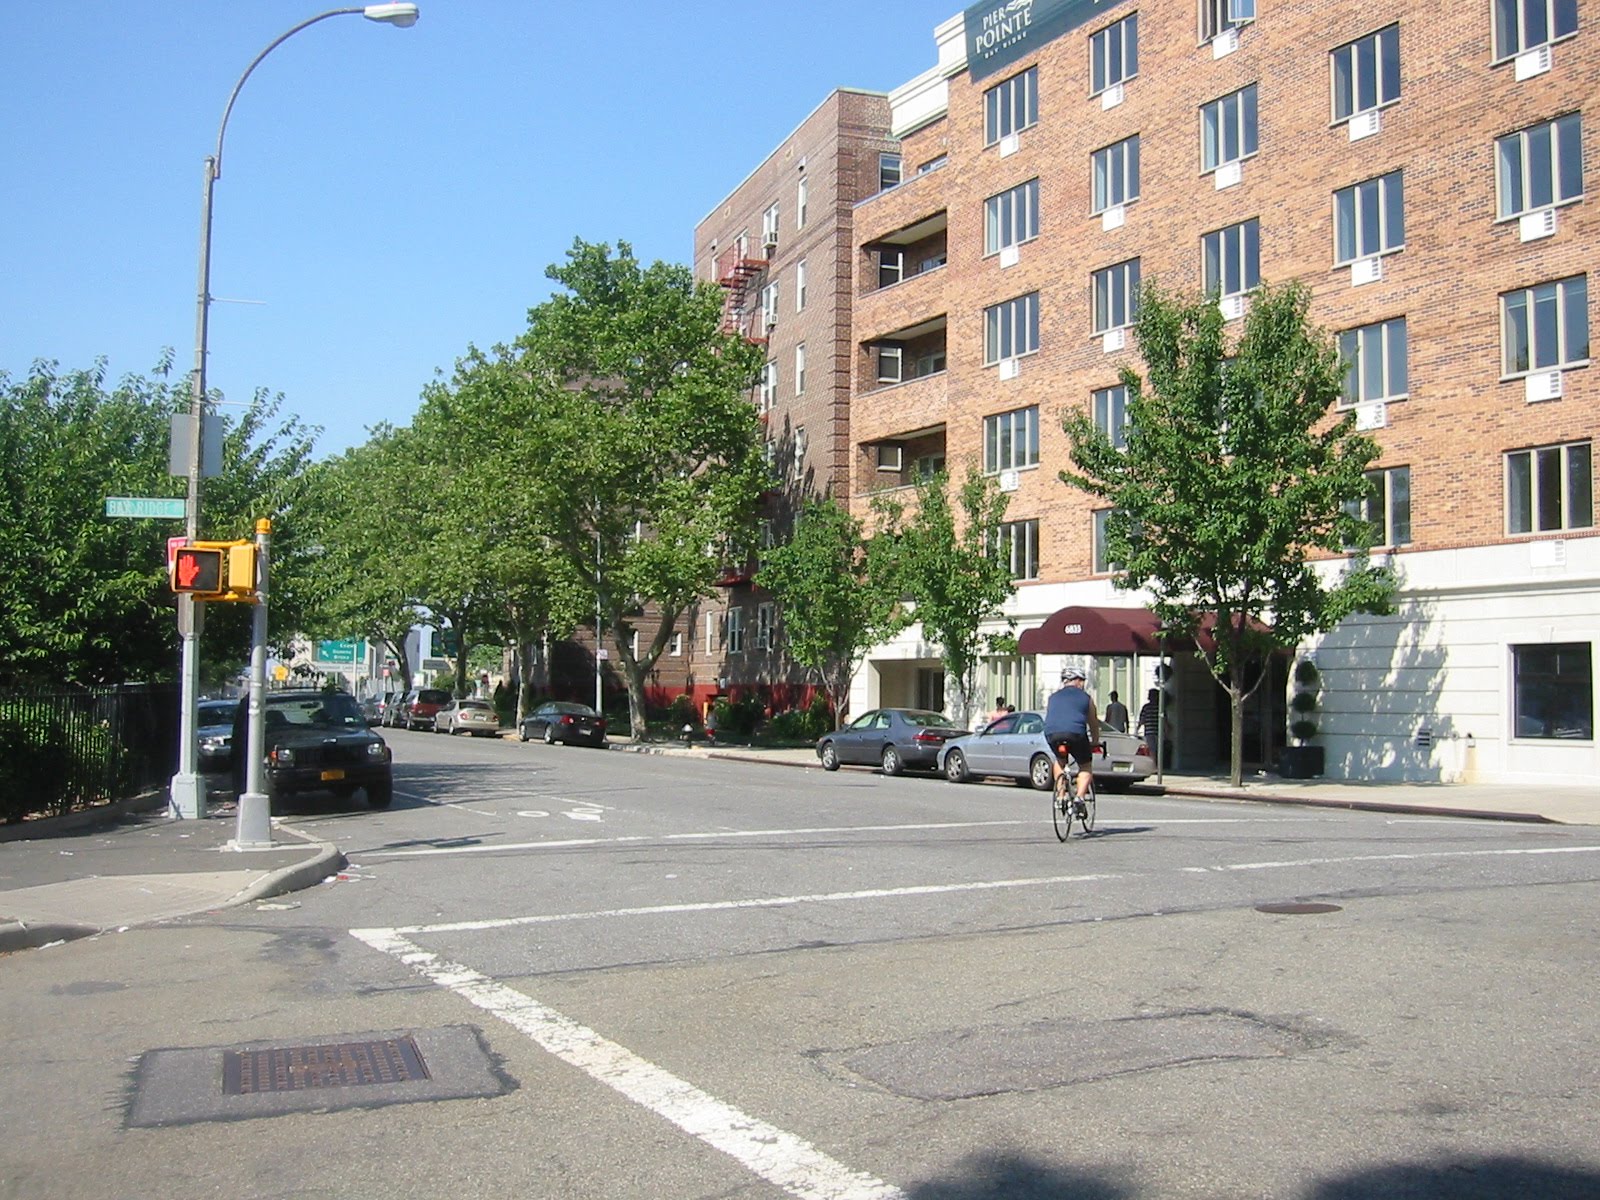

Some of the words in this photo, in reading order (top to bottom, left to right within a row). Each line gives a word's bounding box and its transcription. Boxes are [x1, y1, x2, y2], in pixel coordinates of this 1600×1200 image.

[982, 7, 1007, 30] PIER
[975, 7, 1032, 54] POINTE
[109, 500, 131, 515] BAY
[136, 500, 170, 515] RIDGE
